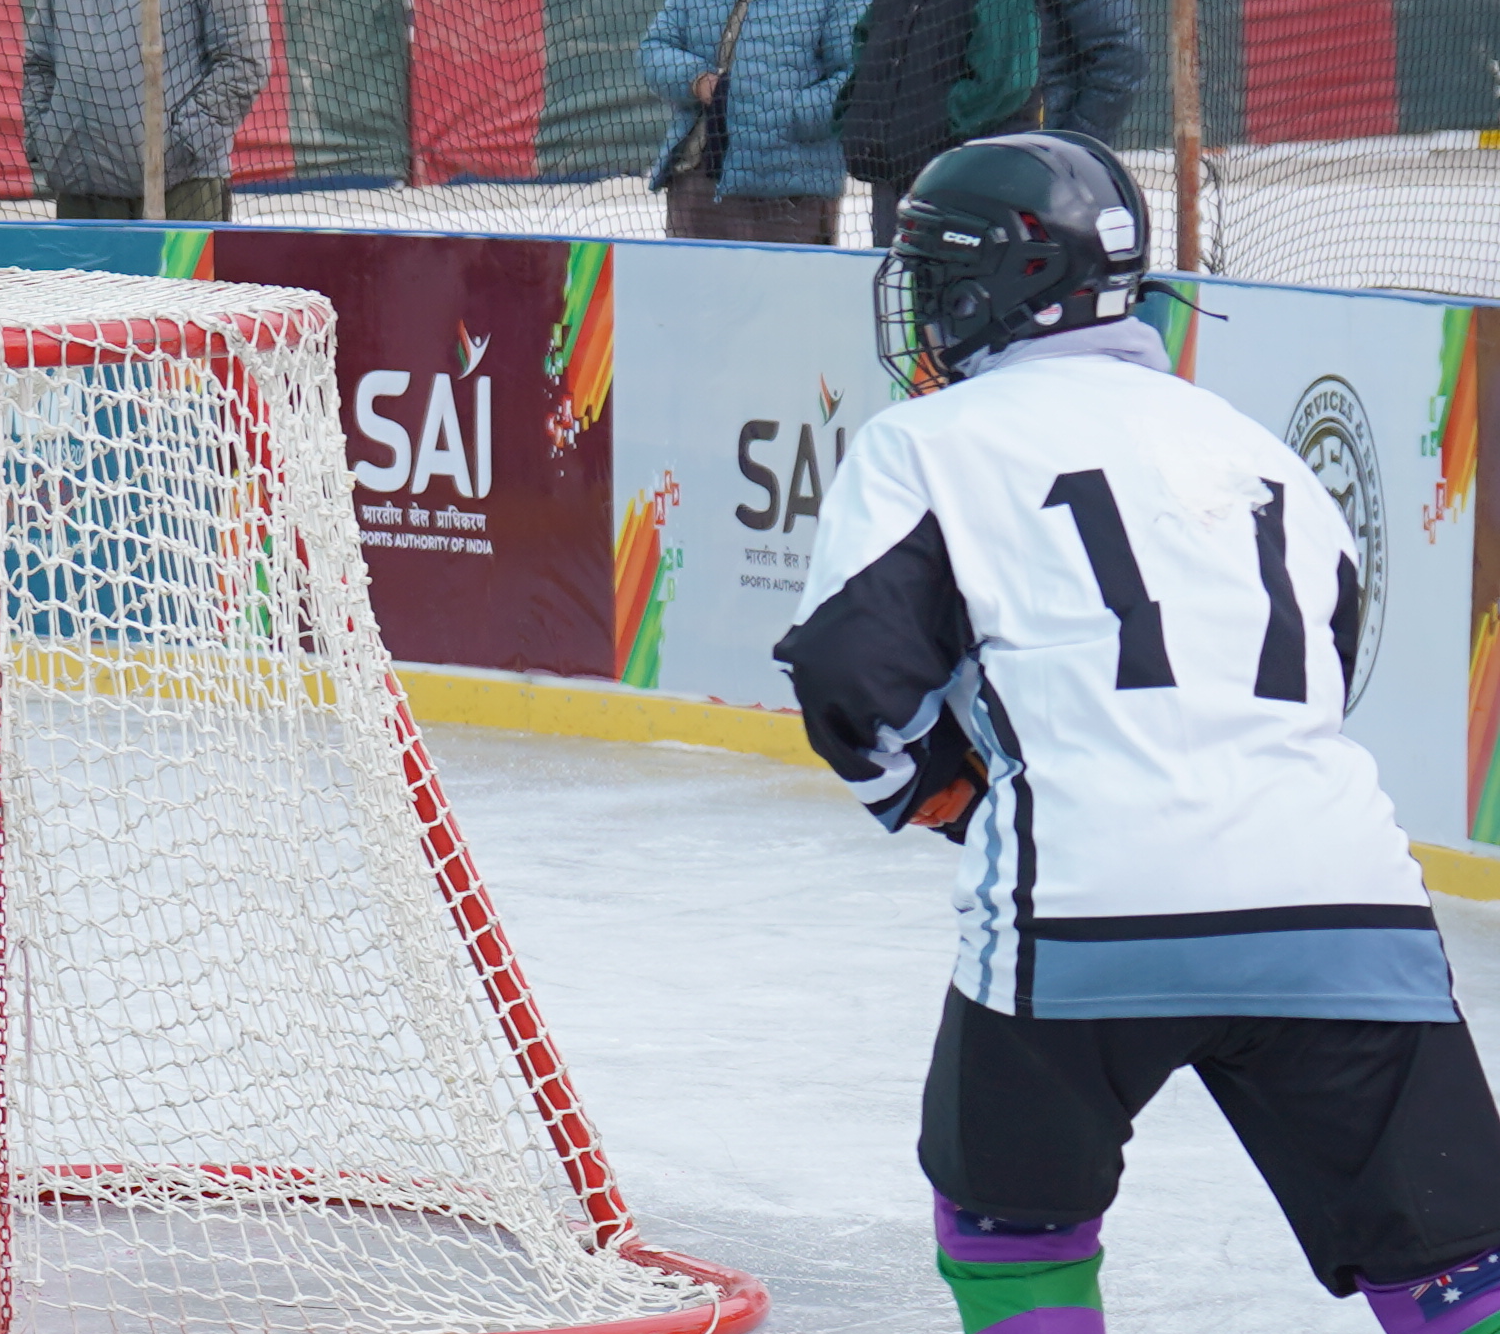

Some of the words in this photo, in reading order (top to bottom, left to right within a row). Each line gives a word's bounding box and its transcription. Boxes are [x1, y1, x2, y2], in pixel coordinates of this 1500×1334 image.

[943, 231, 981, 247] CCM
[354, 369, 492, 499] SAI
[361, 500, 403, 525] भारतीय
[408, 501, 430, 527] खेल
[360, 530, 393, 547] PORTS
[394, 533, 449, 551] AUTHORITY
[451, 538, 463, 552] OF
[466, 539, 493, 555] INDIA
[741, 574, 771, 590] SPORTS
[773, 580, 805, 594] AUTHOR
[1042, 468, 1307, 704] 11
